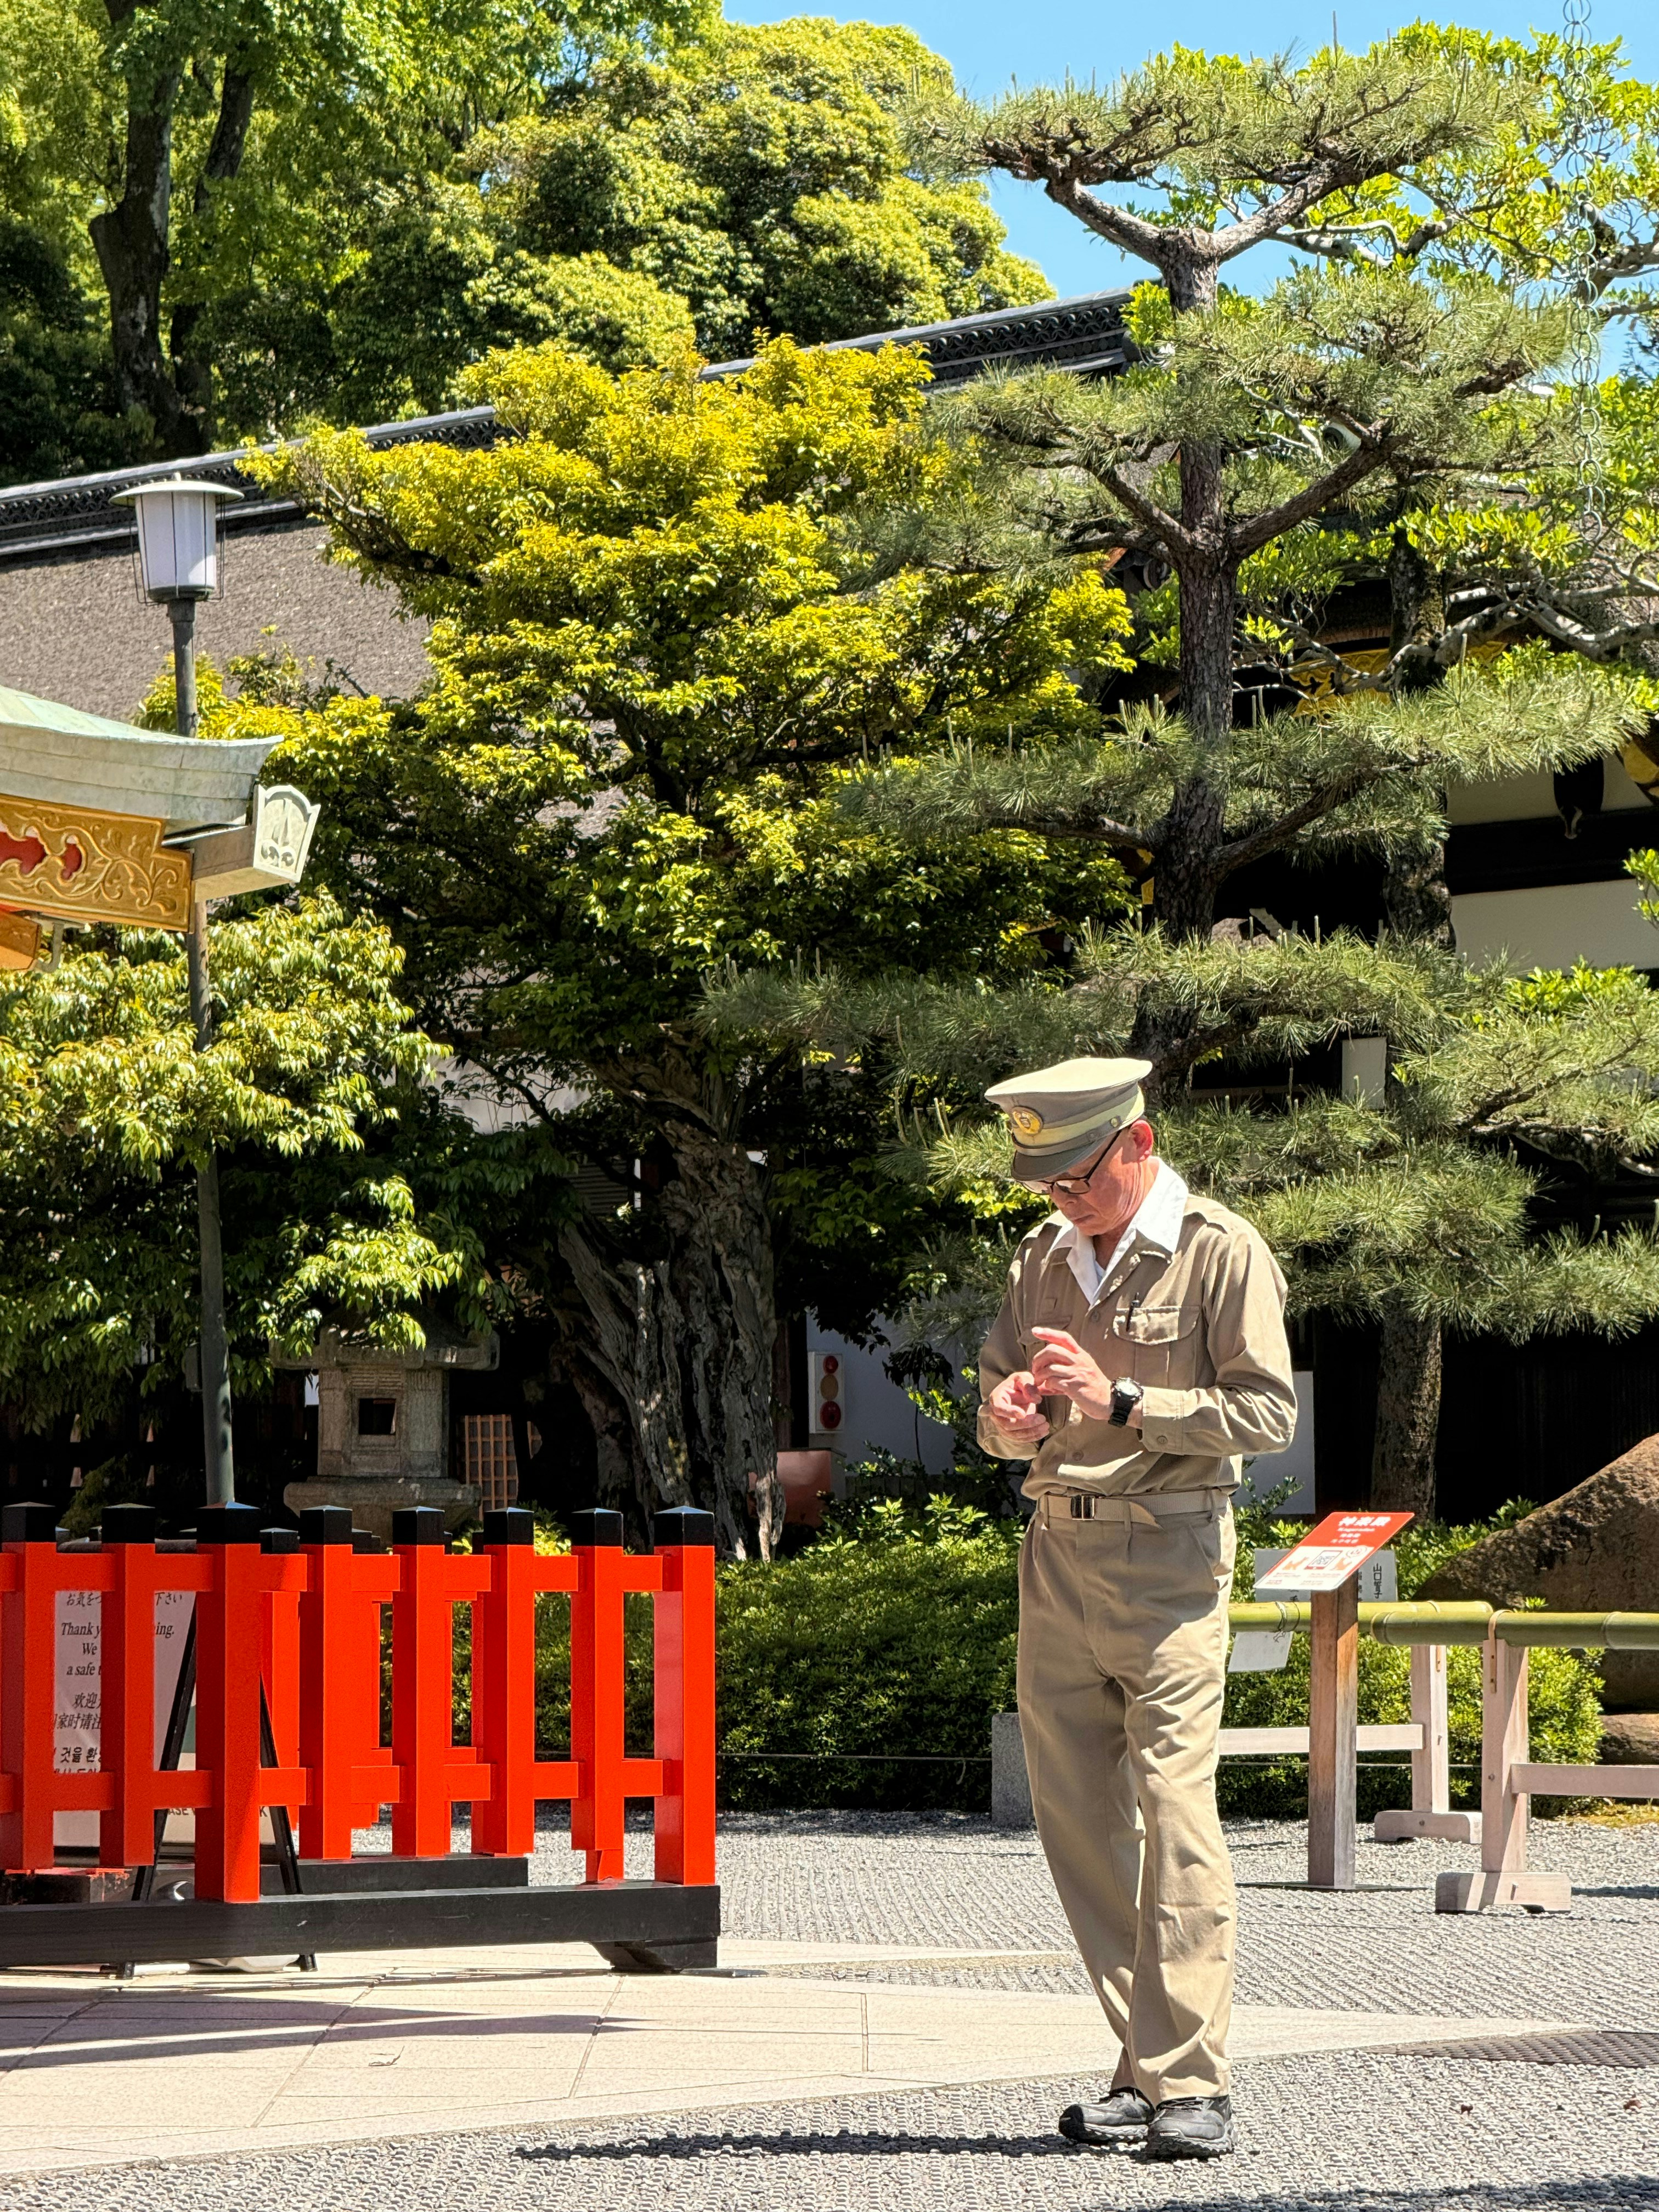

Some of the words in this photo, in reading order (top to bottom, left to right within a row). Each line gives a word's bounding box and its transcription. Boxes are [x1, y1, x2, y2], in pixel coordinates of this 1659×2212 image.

[61, 1622, 93, 1635] Thank
[154, 1622, 174, 1639] ing.
[82, 1643, 98, 1655] We
[66, 1666, 74, 1675] a
[75, 1662, 95, 1675] safe
[53, 1712, 101, 1730] 家时请注
